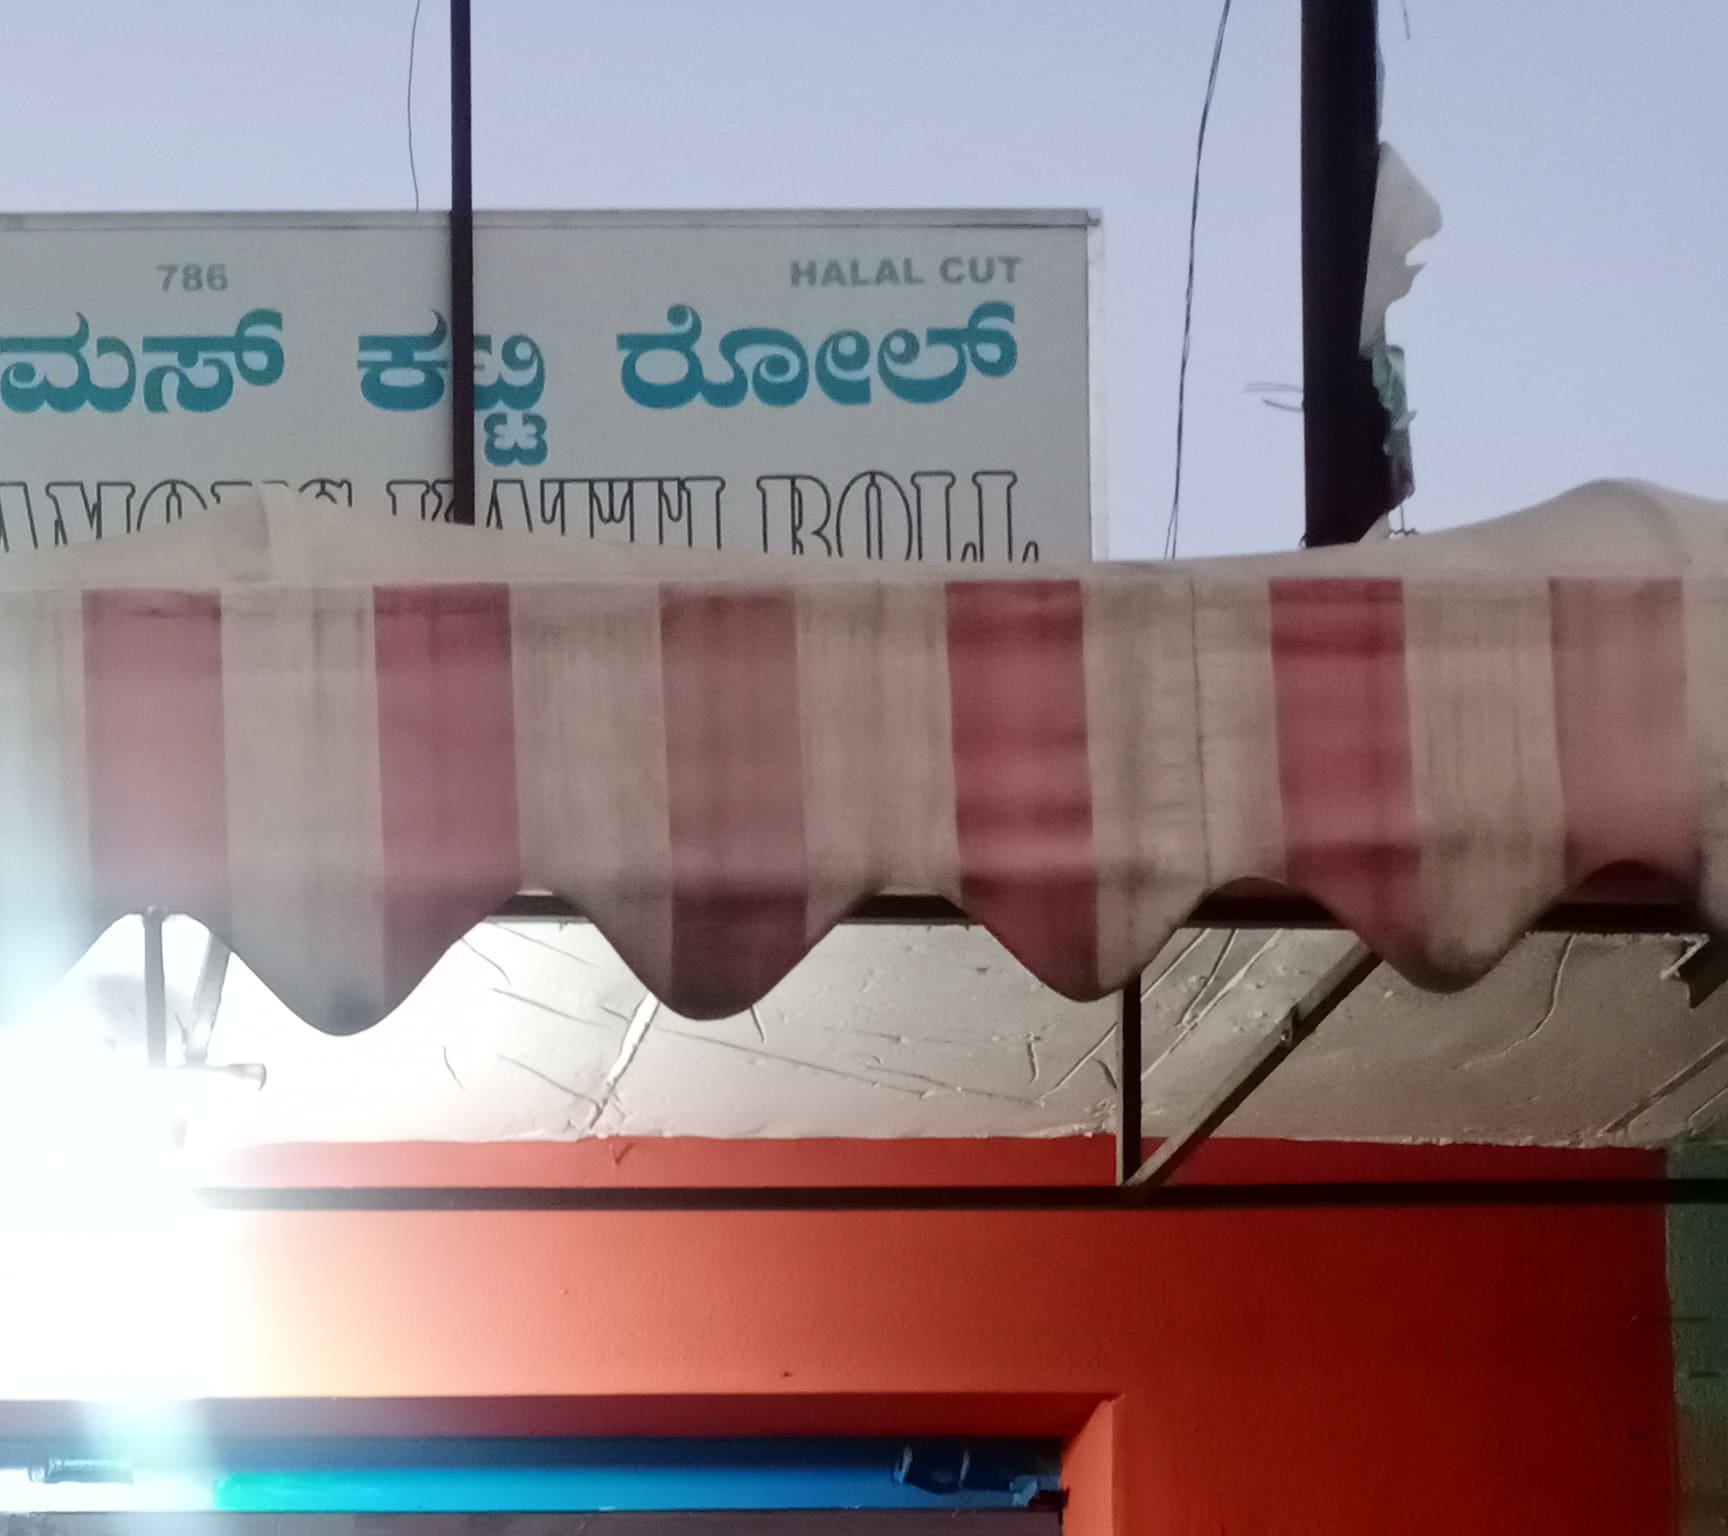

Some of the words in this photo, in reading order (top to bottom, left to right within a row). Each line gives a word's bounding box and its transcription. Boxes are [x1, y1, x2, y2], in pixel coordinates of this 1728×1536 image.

[159, 263, 229, 294] 786
[790, 259, 926, 288] HALAL
[938, 256, 1022, 285] CUT
[615, 300, 1020, 408] ರೋಲ್
